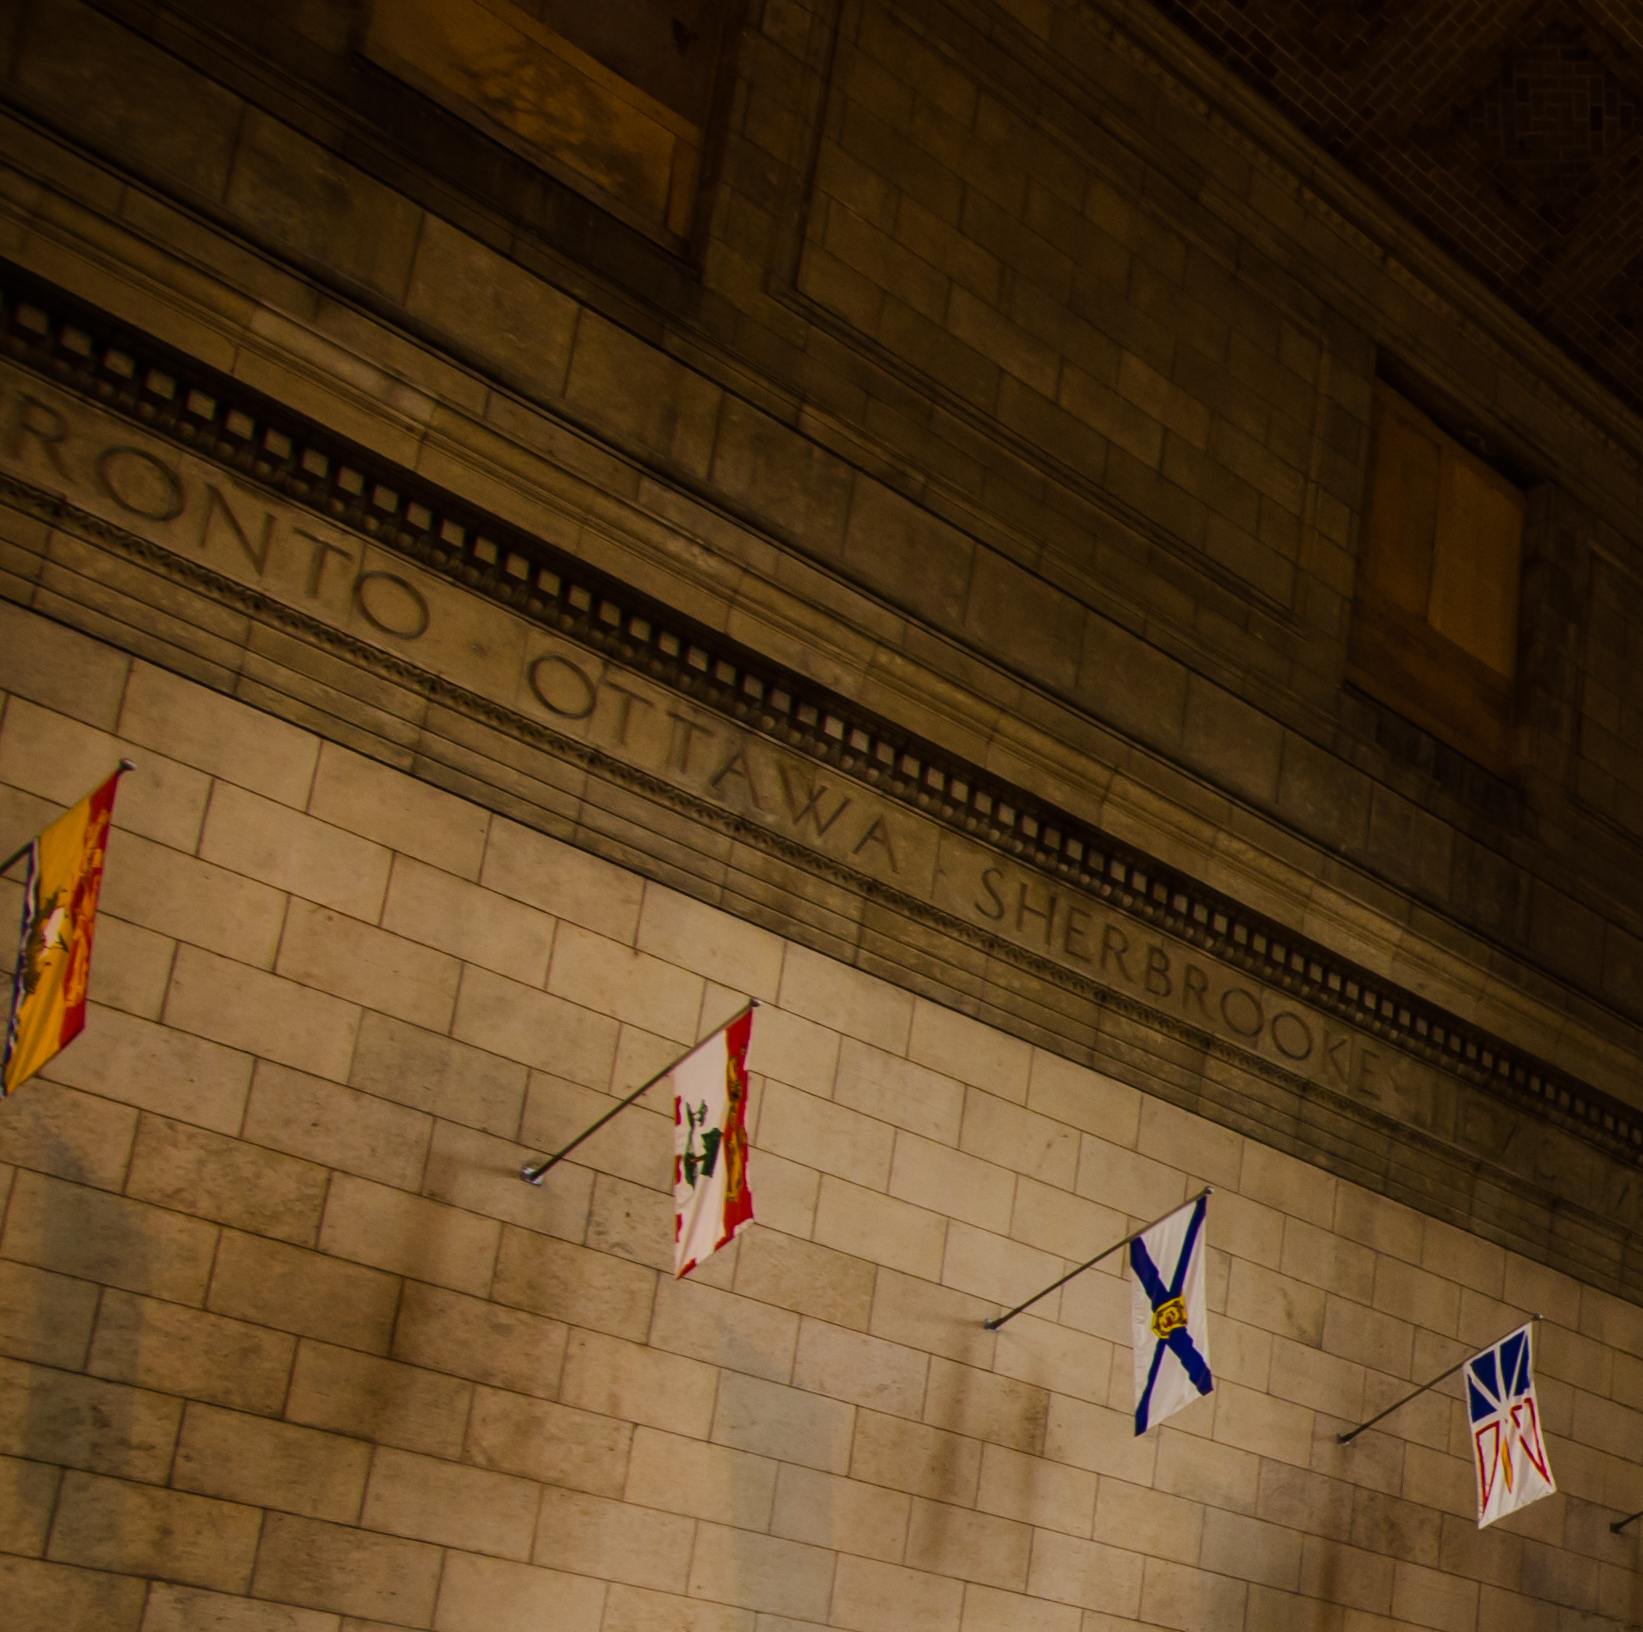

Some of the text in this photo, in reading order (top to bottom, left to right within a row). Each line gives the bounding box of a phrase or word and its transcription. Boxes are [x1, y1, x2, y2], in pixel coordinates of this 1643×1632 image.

[8, 394, 431, 641] RONTO
[528, 655, 901, 875] OTTAWA
[973, 867, 1382, 1098] SHERBROOKE
